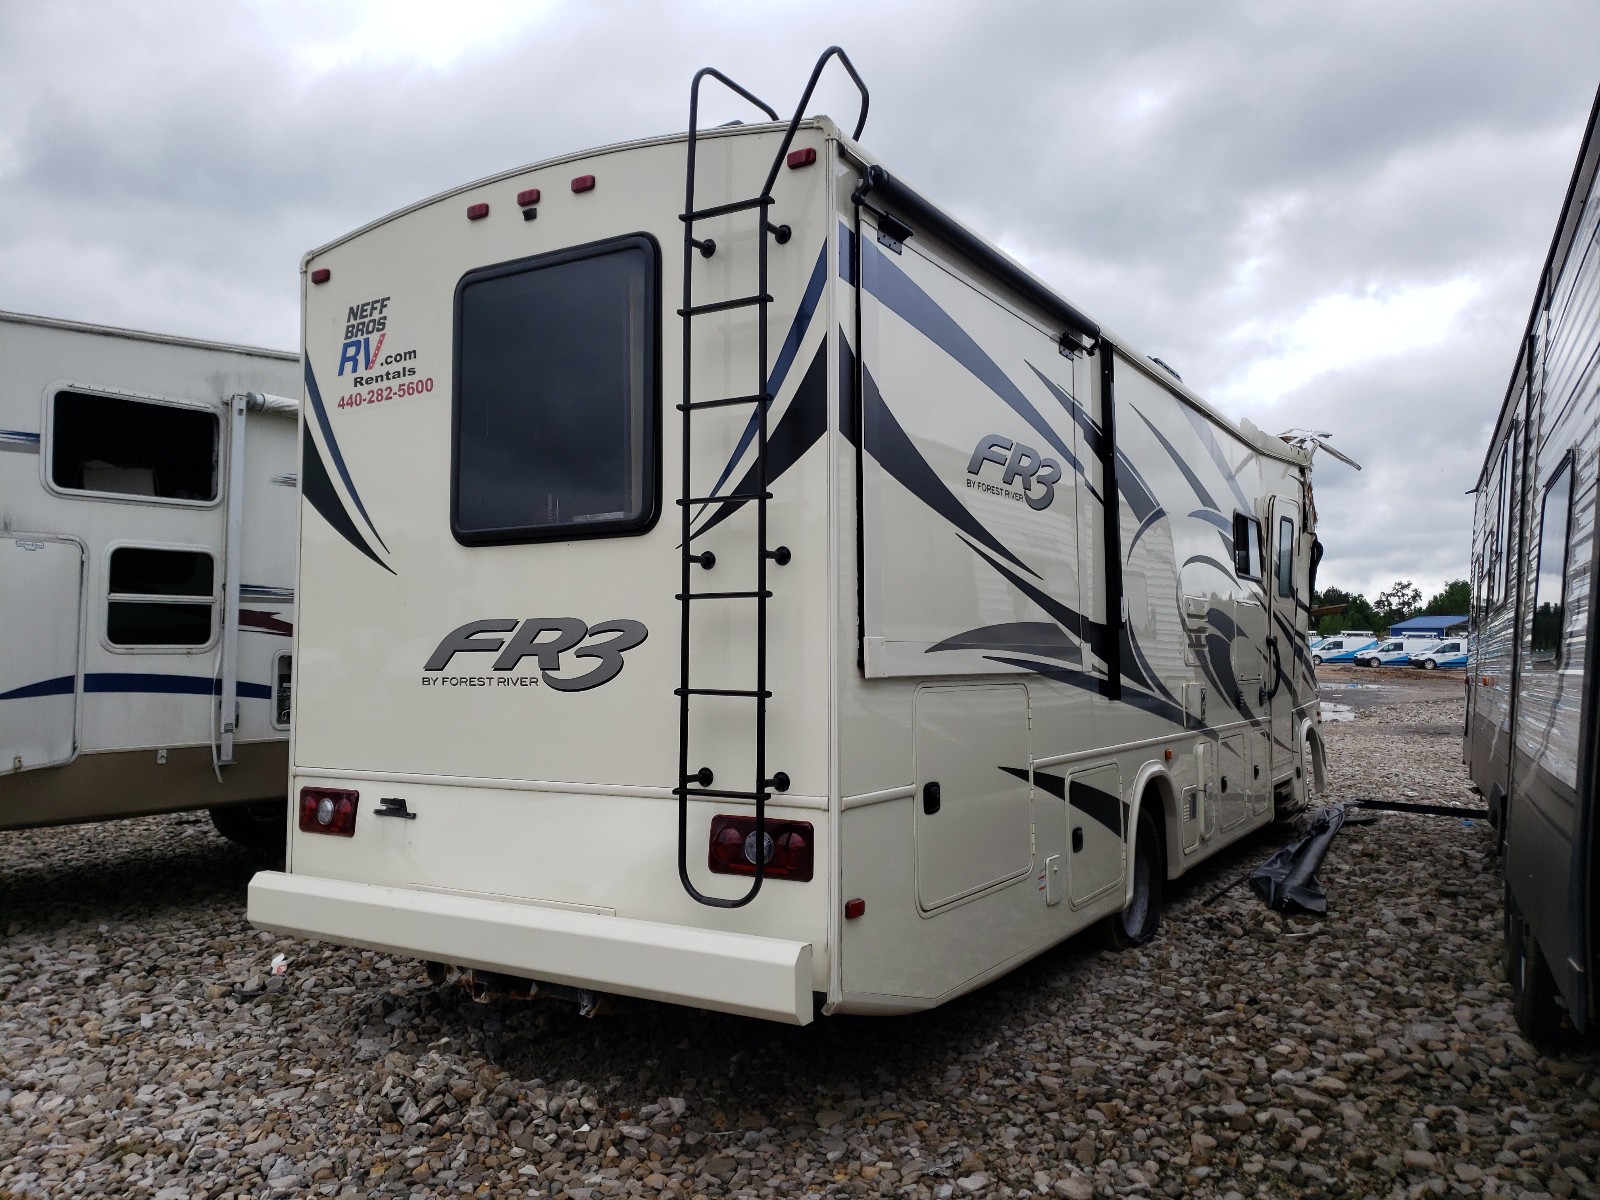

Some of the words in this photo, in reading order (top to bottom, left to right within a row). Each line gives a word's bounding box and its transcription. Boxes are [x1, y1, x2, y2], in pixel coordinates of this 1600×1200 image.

[346, 296, 391, 323] NEFF
[344, 315, 387, 340] BROS
[337, 332, 387, 377] RV
[380, 349, 417, 366] .com
[353, 366, 417, 388] Rentals
[337, 377, 434, 410] 440-282-5600
[966, 433, 1062, 511] FR3
[966, 478, 976, 489] BY
[977, 481, 1004, 497] FOREST
[1004, 490, 1024, 503] RIVER
[422, 617, 649, 692] FR3
[421, 676, 439, 686] BY
[441, 676, 495, 687] FOREST
[497, 676, 539, 687] RIVER
